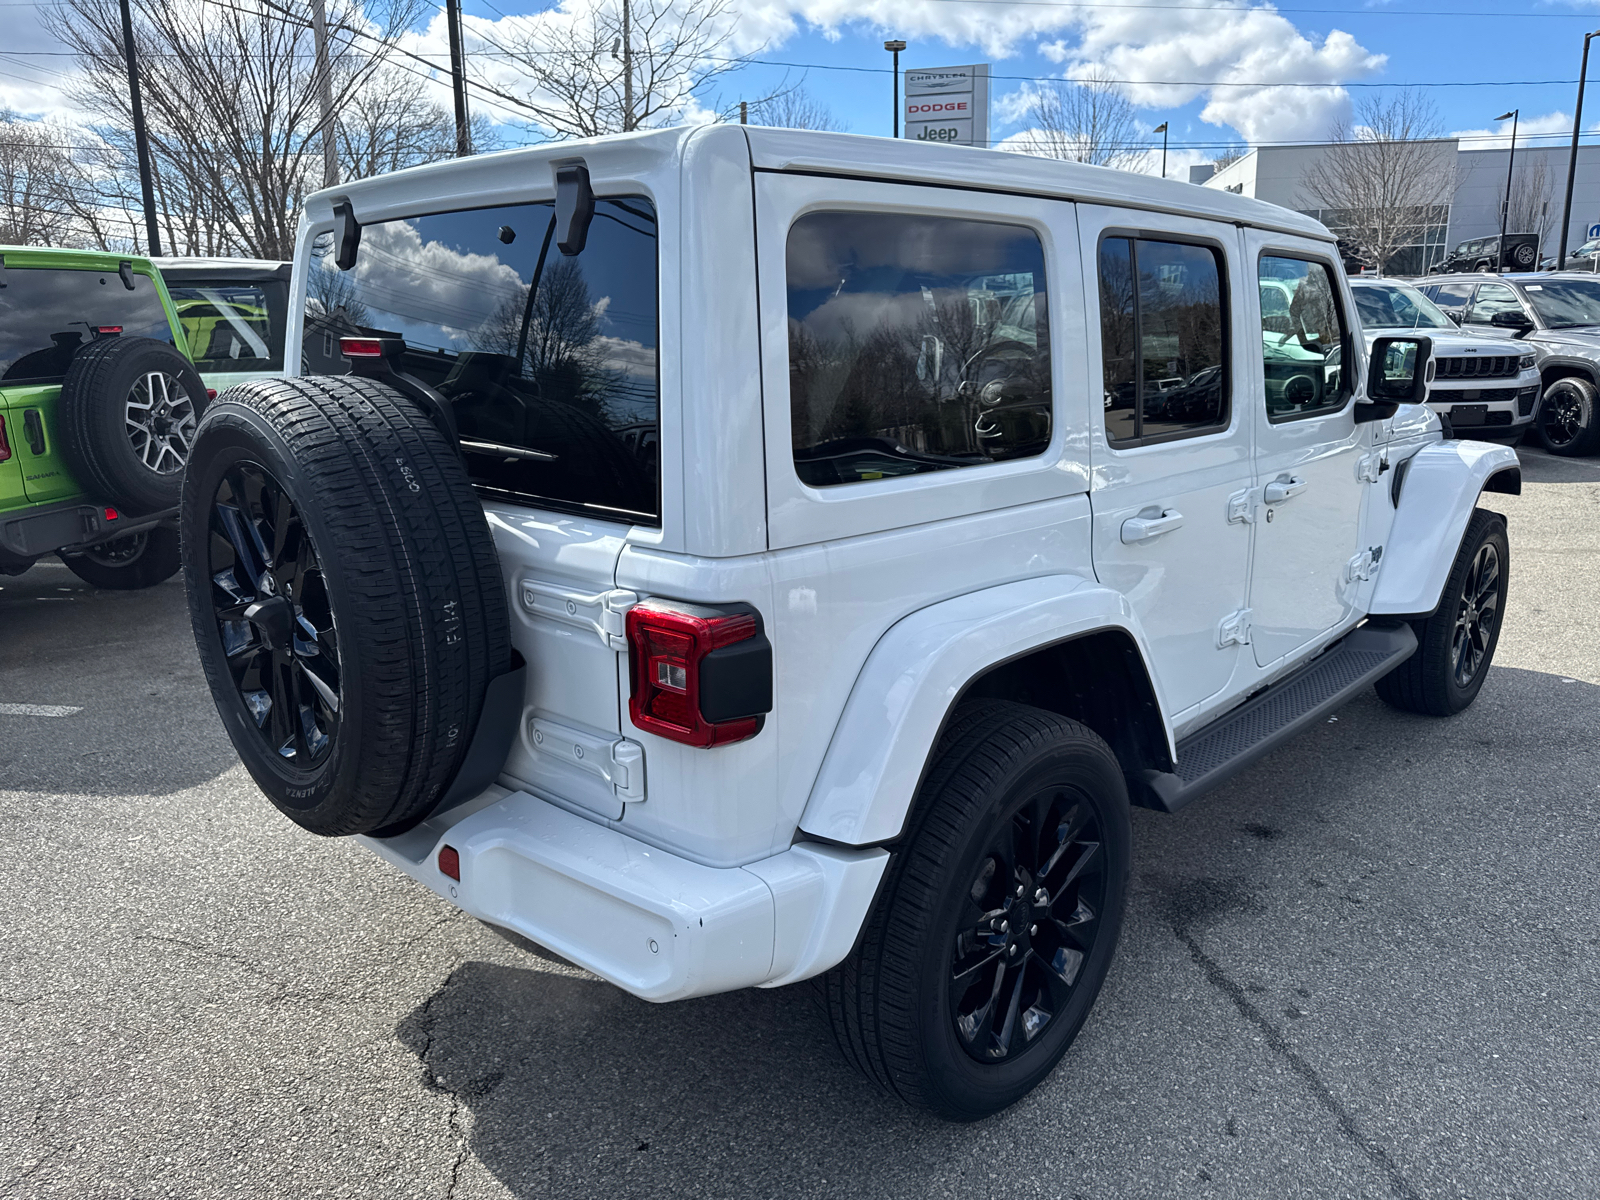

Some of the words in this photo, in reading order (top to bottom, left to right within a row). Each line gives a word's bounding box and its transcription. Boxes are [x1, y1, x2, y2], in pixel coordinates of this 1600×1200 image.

[910, 73, 966, 82] CHRYSLER
[908, 102, 968, 113] DODGE
[917, 126, 958, 142] Jeep
[285, 785, 315, 799] ALENZA
